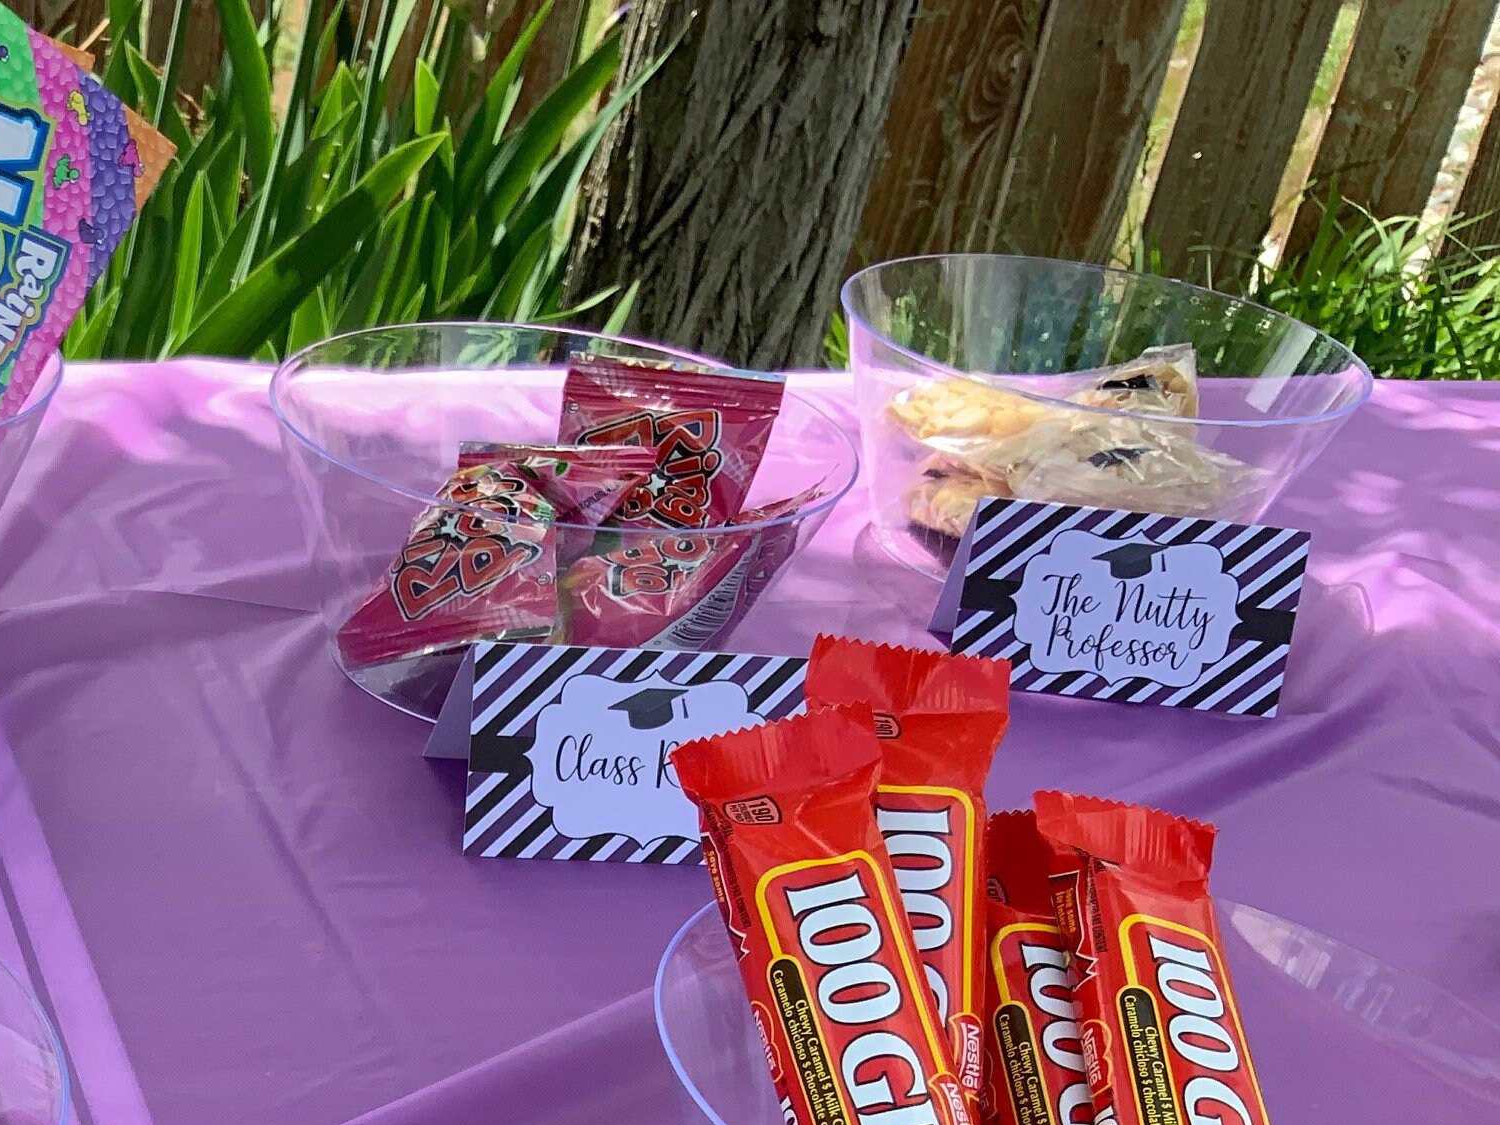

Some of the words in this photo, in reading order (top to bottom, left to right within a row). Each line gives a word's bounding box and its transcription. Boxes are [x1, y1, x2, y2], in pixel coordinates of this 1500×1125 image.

[1040, 573, 1101, 617] The
[1114, 579, 1216, 651] Nutty
[1044, 612, 1191, 673] Professor
[554, 733, 647, 787] Class
[749, 798, 775, 823] 190
[784, 870, 903, 1028] 100
[1123, 994, 1141, 1038] Caramelo
[1132, 1039, 1149, 1079] chicloso
[1148, 934, 1239, 1074] 100
[772, 969, 793, 1019] Caramelo
[787, 1018, 808, 1062] chicloso
[804, 1068, 826, 1121] chocolate
[795, 998, 814, 1037] Chewy
[806, 1036, 831, 1085] Caramel
[823, 1091, 843, 1119] Milk
[959, 1022, 981, 1092] Nestlé
[999, 1012, 1016, 1058] Caramelo
[1009, 1059, 1025, 1098] chicloso
[1018, 1040, 1035, 1075] Chewy
[1081, 1027, 1102, 1087] Nestlé
[1143, 1026, 1160, 1060] Chewy
[1026, 1076, 1044, 1119] Caramel
[1151, 1060, 1173, 1101] Caramel
